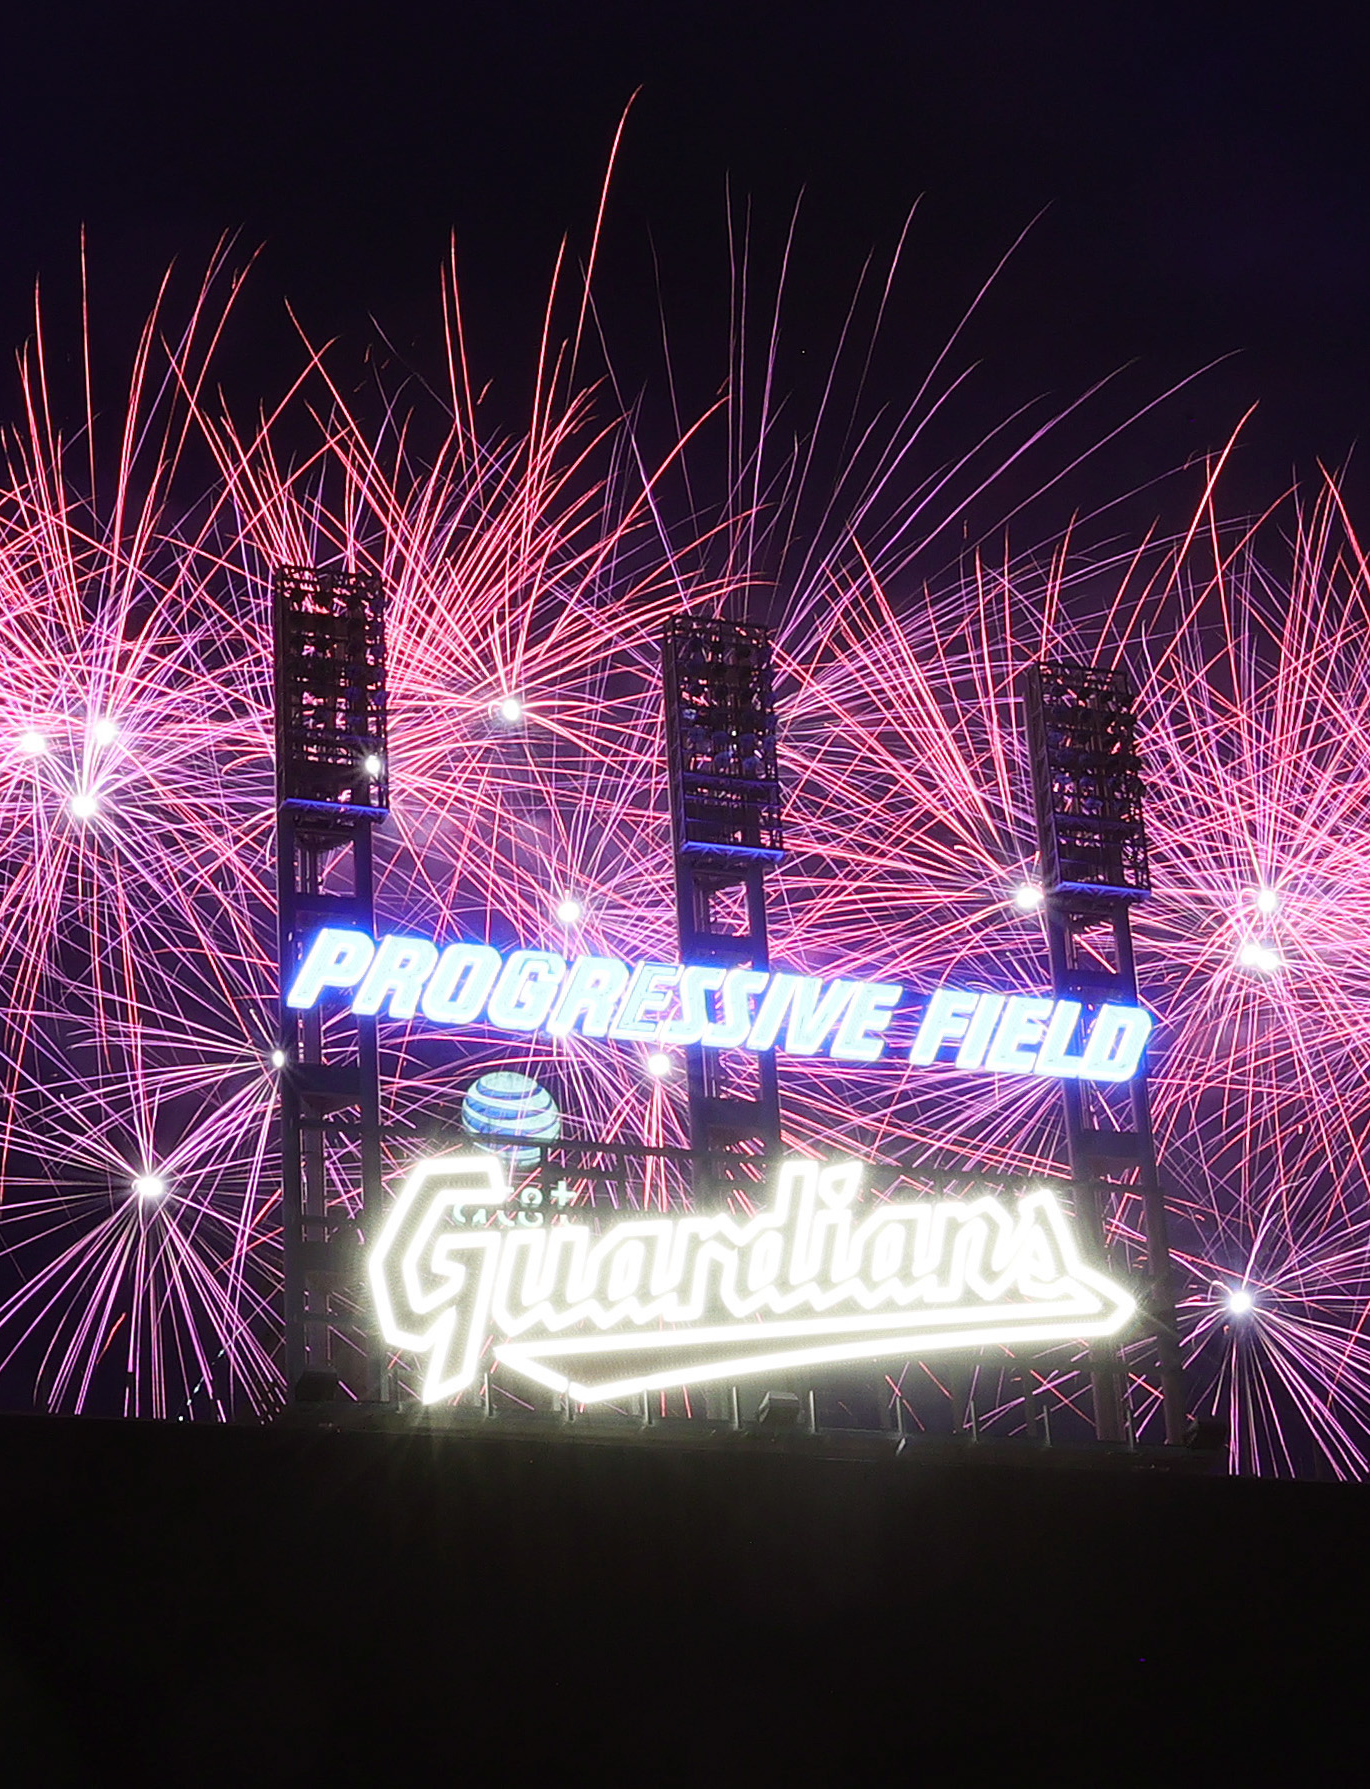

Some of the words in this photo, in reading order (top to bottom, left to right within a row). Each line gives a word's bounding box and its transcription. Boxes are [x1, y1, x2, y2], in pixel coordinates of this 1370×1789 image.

[286, 928, 903, 1063] PROGRESSIVE
[908, 987, 1153, 1083] FIELD
[370, 1156, 1089, 1404] Guardians
